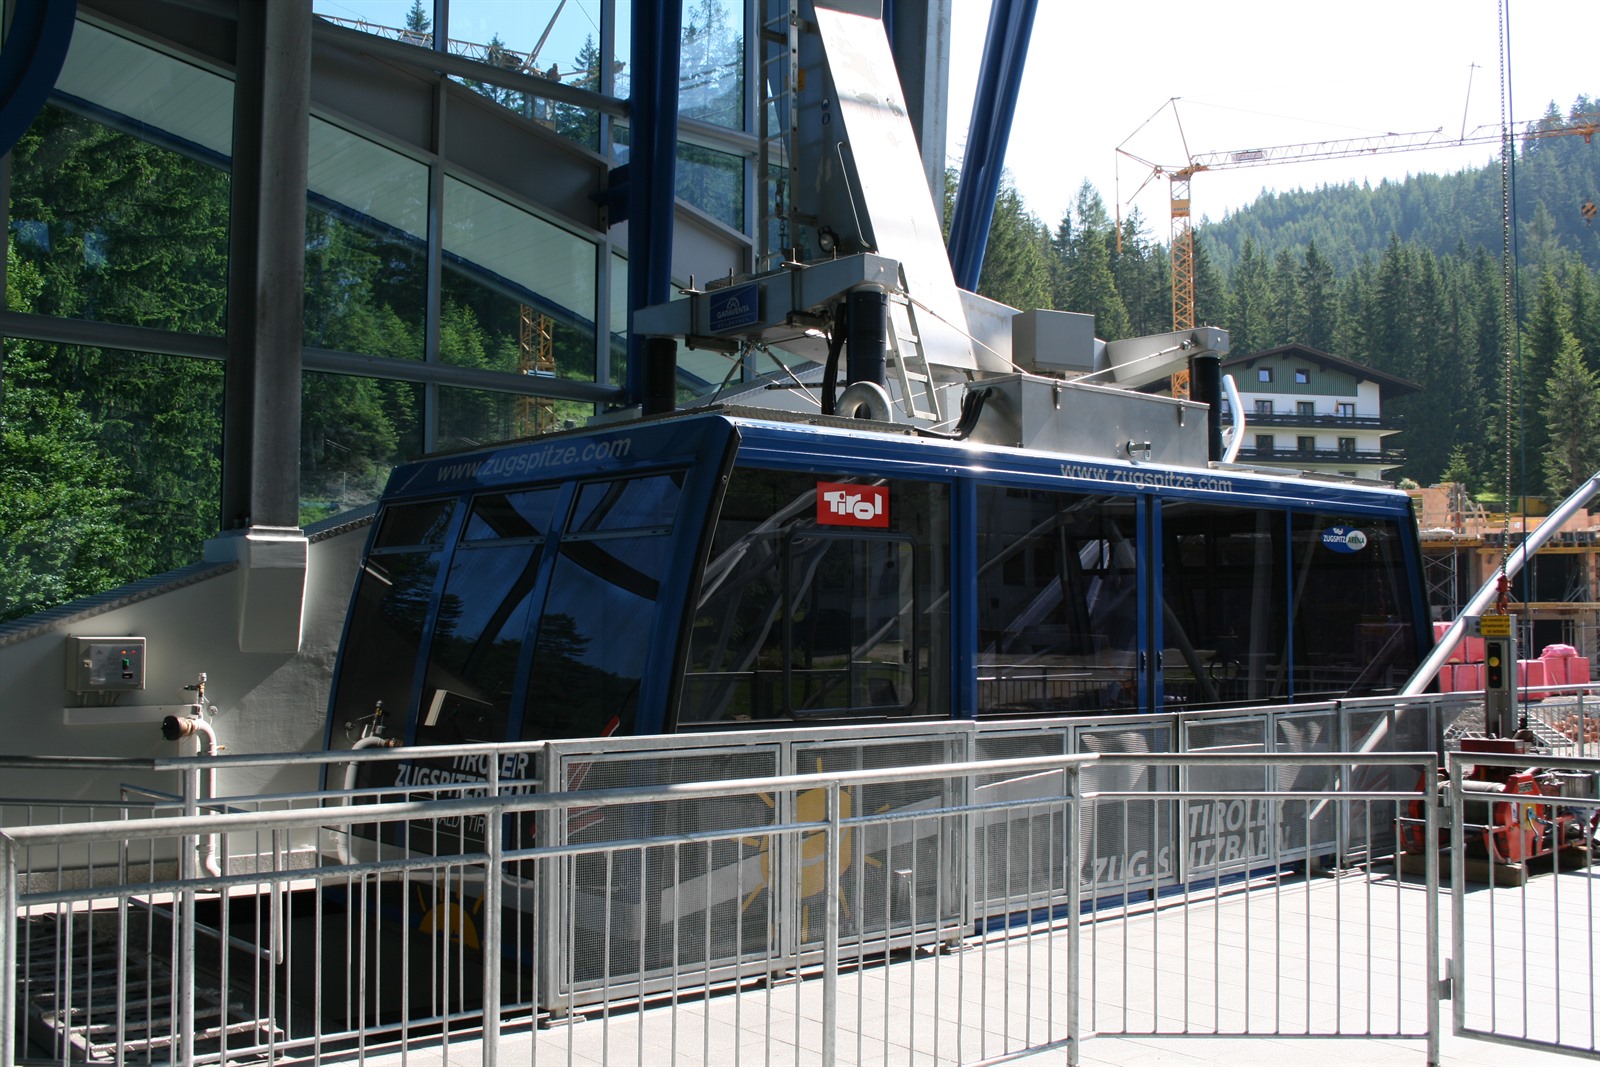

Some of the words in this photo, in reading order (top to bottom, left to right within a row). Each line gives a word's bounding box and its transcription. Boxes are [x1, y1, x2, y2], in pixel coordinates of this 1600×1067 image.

[717, 305, 750, 319] GARAVENTA
[437, 438, 632, 482] www.zugspitze.com
[1060, 464, 1233, 492] wwwzugspitze.com
[823, 491, 883, 520] Tirol
[1323, 534, 1346, 543] ZUGSPITZ
[1348, 536, 1364, 544] ARENA
[453, 753, 529, 779] TIROER
[394, 764, 531, 798] ZUGSPITZB
[1091, 826, 1291, 882] ZUGSITZBAHN
